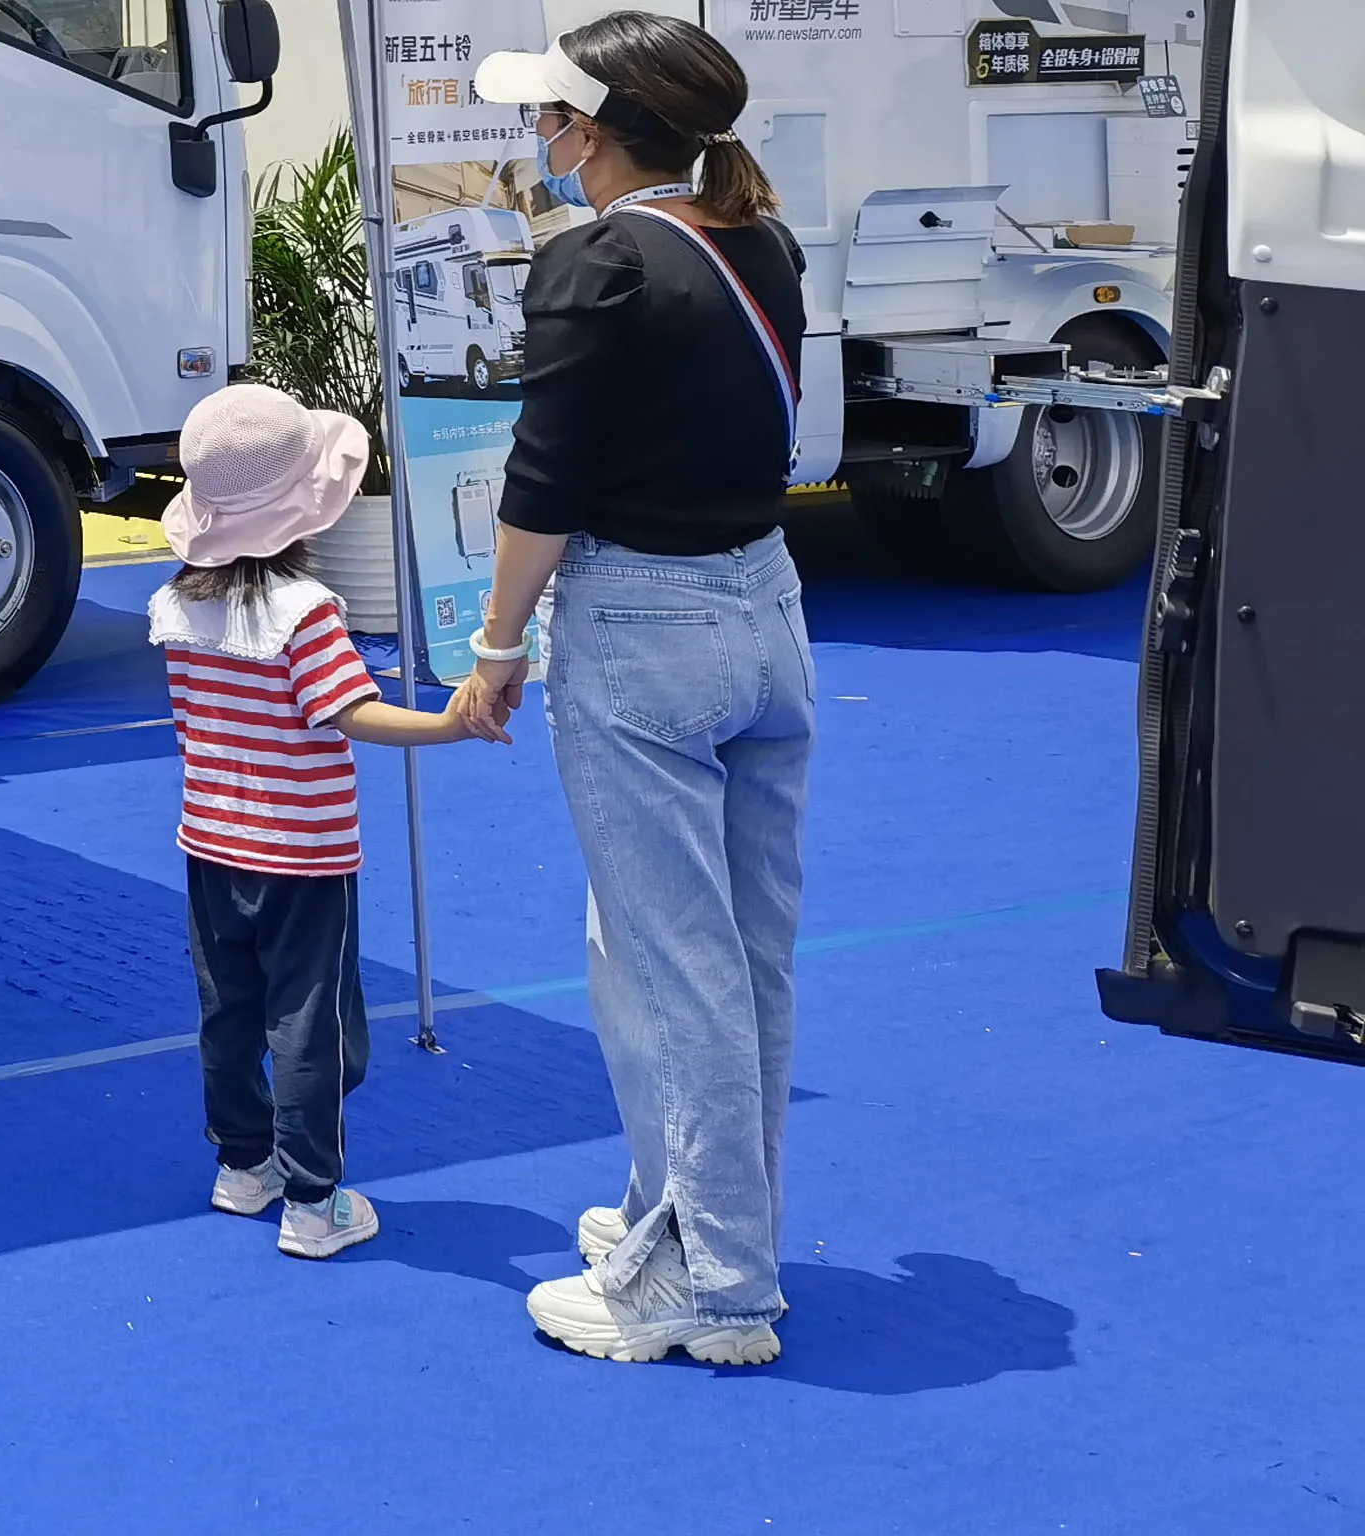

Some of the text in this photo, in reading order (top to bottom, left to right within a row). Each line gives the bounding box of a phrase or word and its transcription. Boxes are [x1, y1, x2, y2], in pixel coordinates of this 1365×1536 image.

[745, 26, 862, 41] www.newstarrv.com
[978, 32, 1030, 52] 箱体尊享
[1040, 47, 1140, 68] 全铝车身+铝骨架
